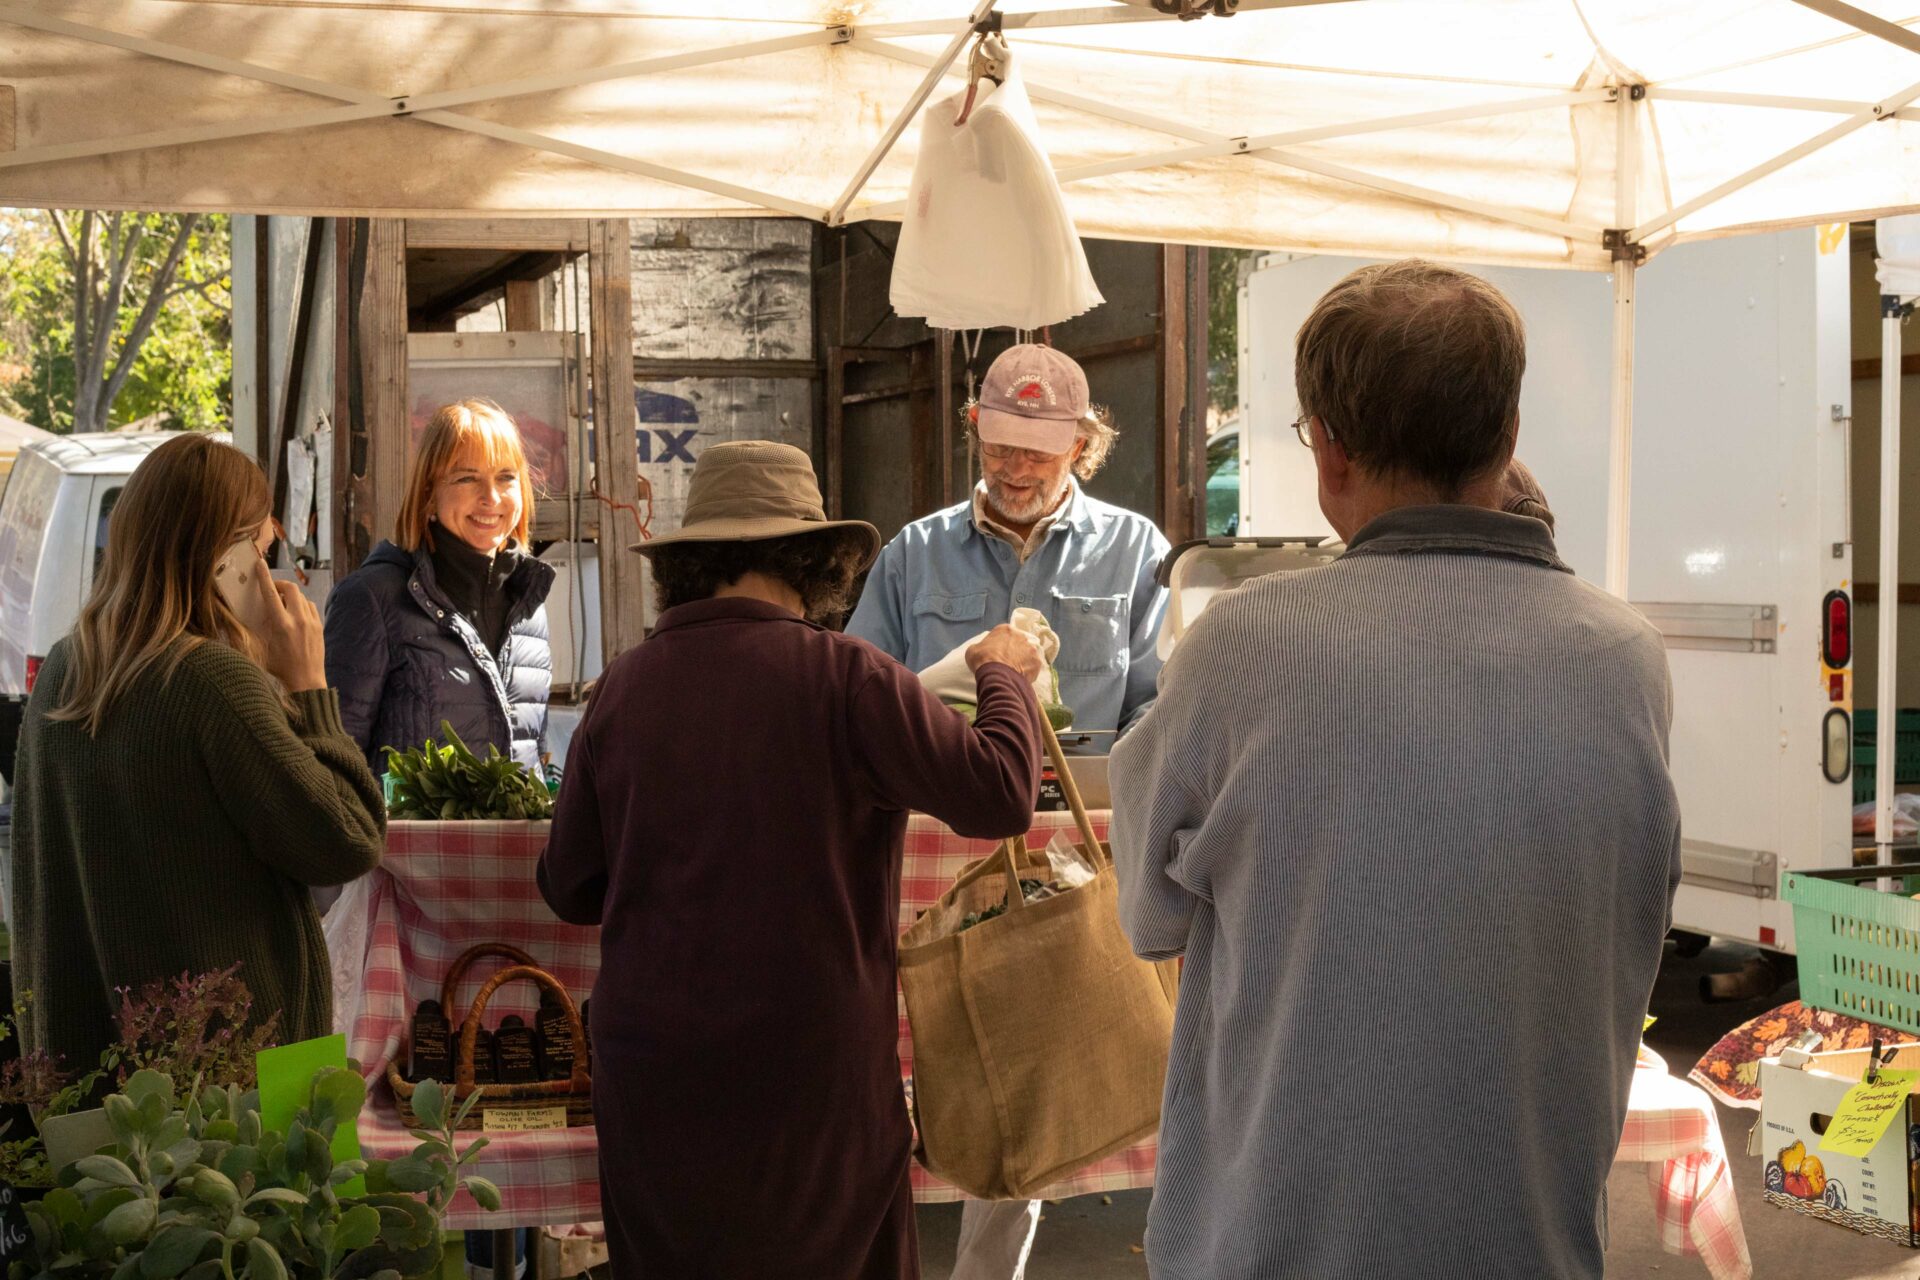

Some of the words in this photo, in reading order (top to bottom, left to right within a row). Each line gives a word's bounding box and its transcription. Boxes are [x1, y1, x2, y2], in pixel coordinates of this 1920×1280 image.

[1012, 374, 1042, 387] HARBOR
[1040, 378, 1057, 406] LOBSTER
[1040, 785, 1055, 793] PC
[527, 1109, 553, 1117] FARMS
